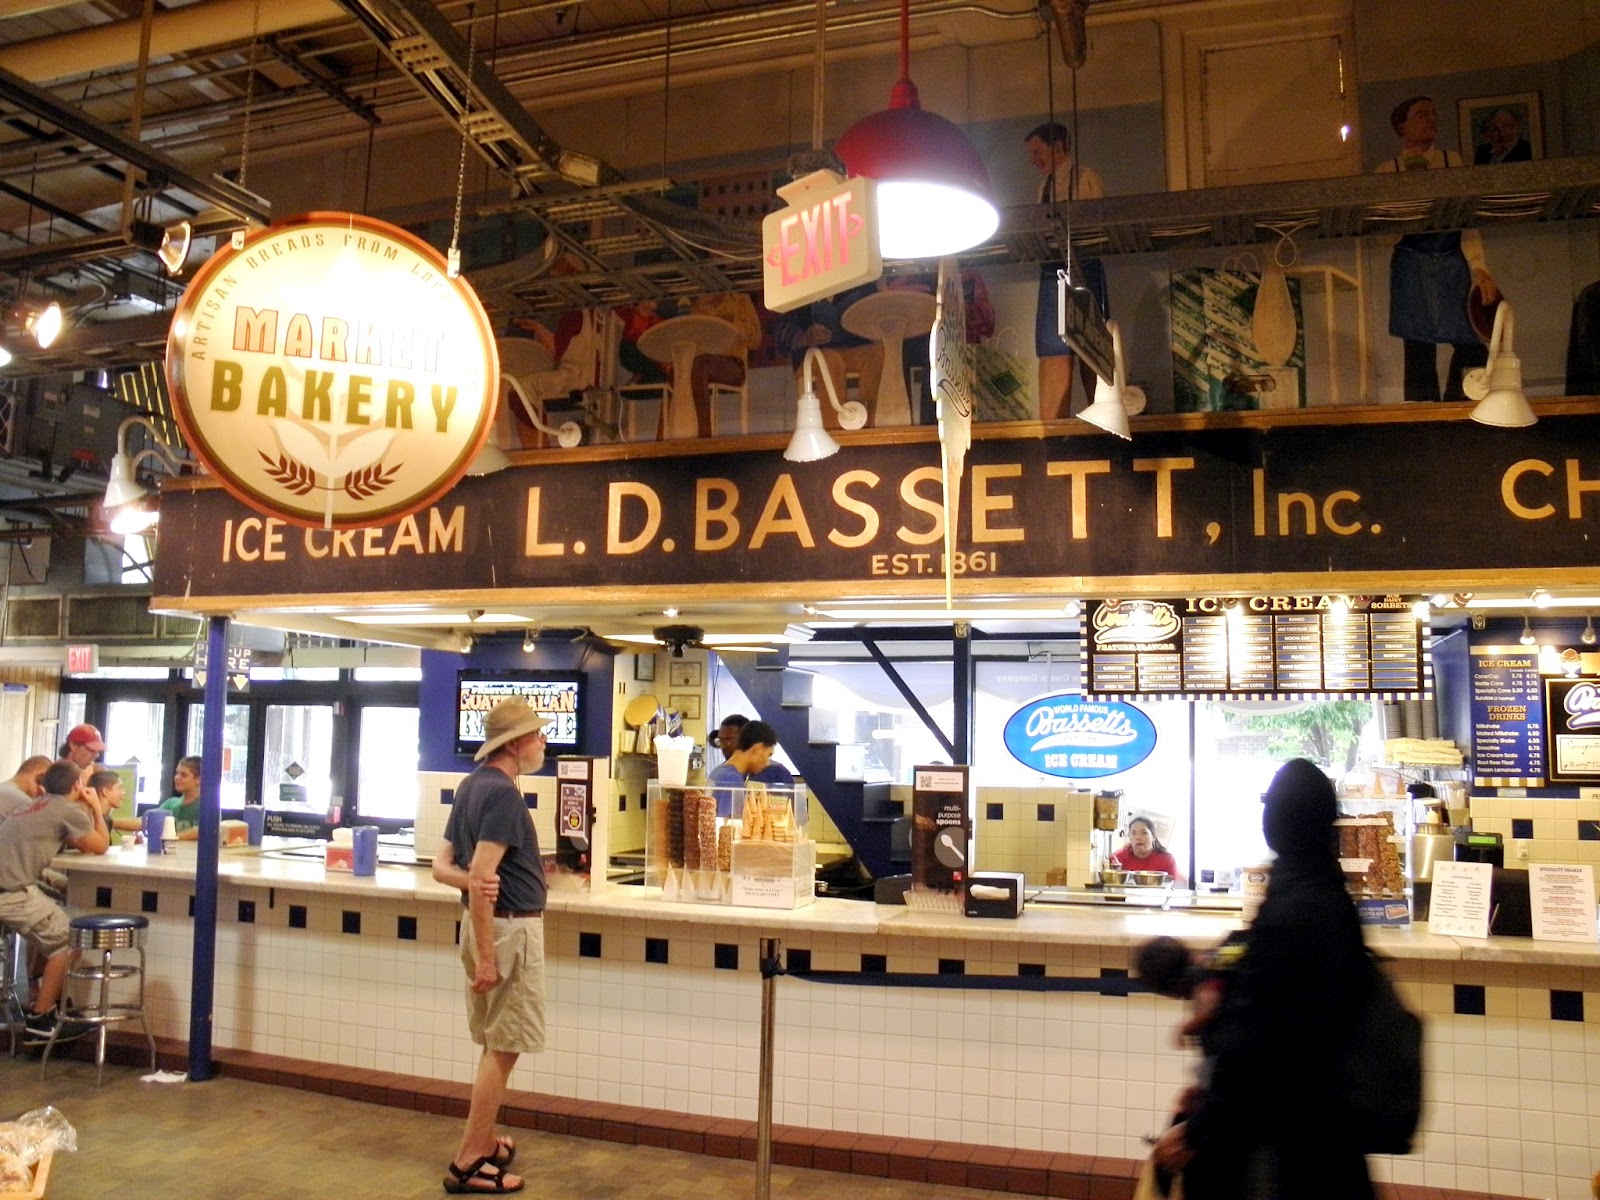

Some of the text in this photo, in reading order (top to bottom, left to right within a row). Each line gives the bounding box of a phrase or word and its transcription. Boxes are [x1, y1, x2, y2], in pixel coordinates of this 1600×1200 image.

[780, 191, 852, 287] EXIT
[191, 277, 238, 361] ARTISAN
[246, 233, 325, 269] BREADS
[343, 235, 399, 262] FROM
[233, 305, 445, 372] MARKET
[210, 360, 458, 433] BAKERY
[222, 517, 286, 563] ICE
[304, 505, 465, 558] CREAM
[1252, 467, 1383, 537] Inc.
[871, 553, 933, 575] EST.
[1185, 597, 1238, 612] IC
[1096, 643, 1175, 651] FEATURE FLAVORS
[68, 646, 92, 671] EXIT
[195, 653, 250, 670] HRE
[1497, 659, 1532, 667] CREAM
[1053, 704, 1109, 714] WORLD FAMOUS
[1487, 705, 1527, 713] FROZEN
[1489, 713, 1527, 721] DRINKS
[1026, 706, 1138, 737] Bassetts
[1044, 752, 1118, 769] ICE CREAM
